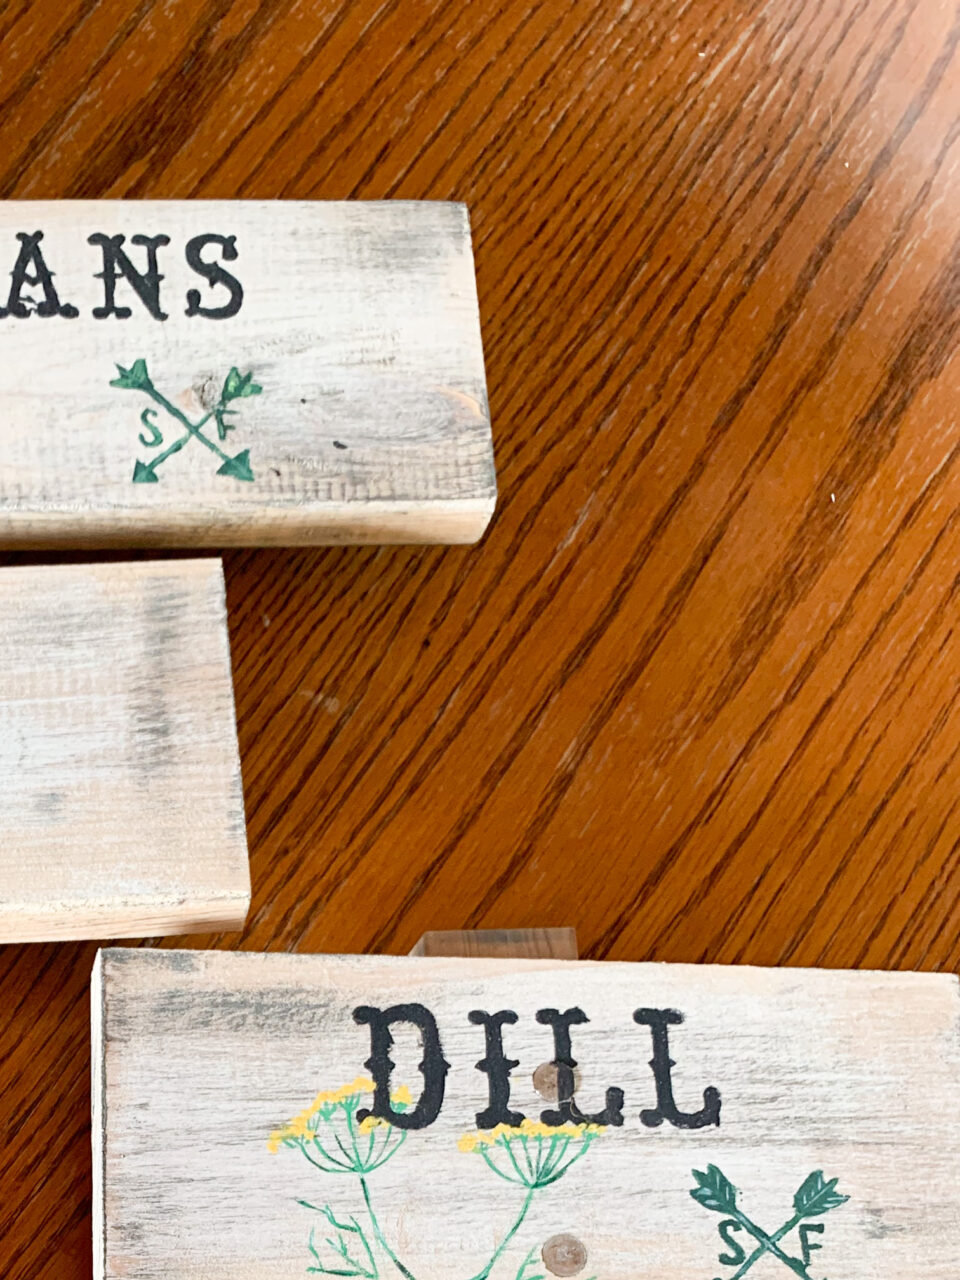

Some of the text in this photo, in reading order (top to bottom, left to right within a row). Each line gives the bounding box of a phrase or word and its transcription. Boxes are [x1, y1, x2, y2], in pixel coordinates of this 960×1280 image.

[138, 407, 240, 448] S F
[351, 1002, 722, 1130] DILL
[717, 1218, 826, 1267] S F
